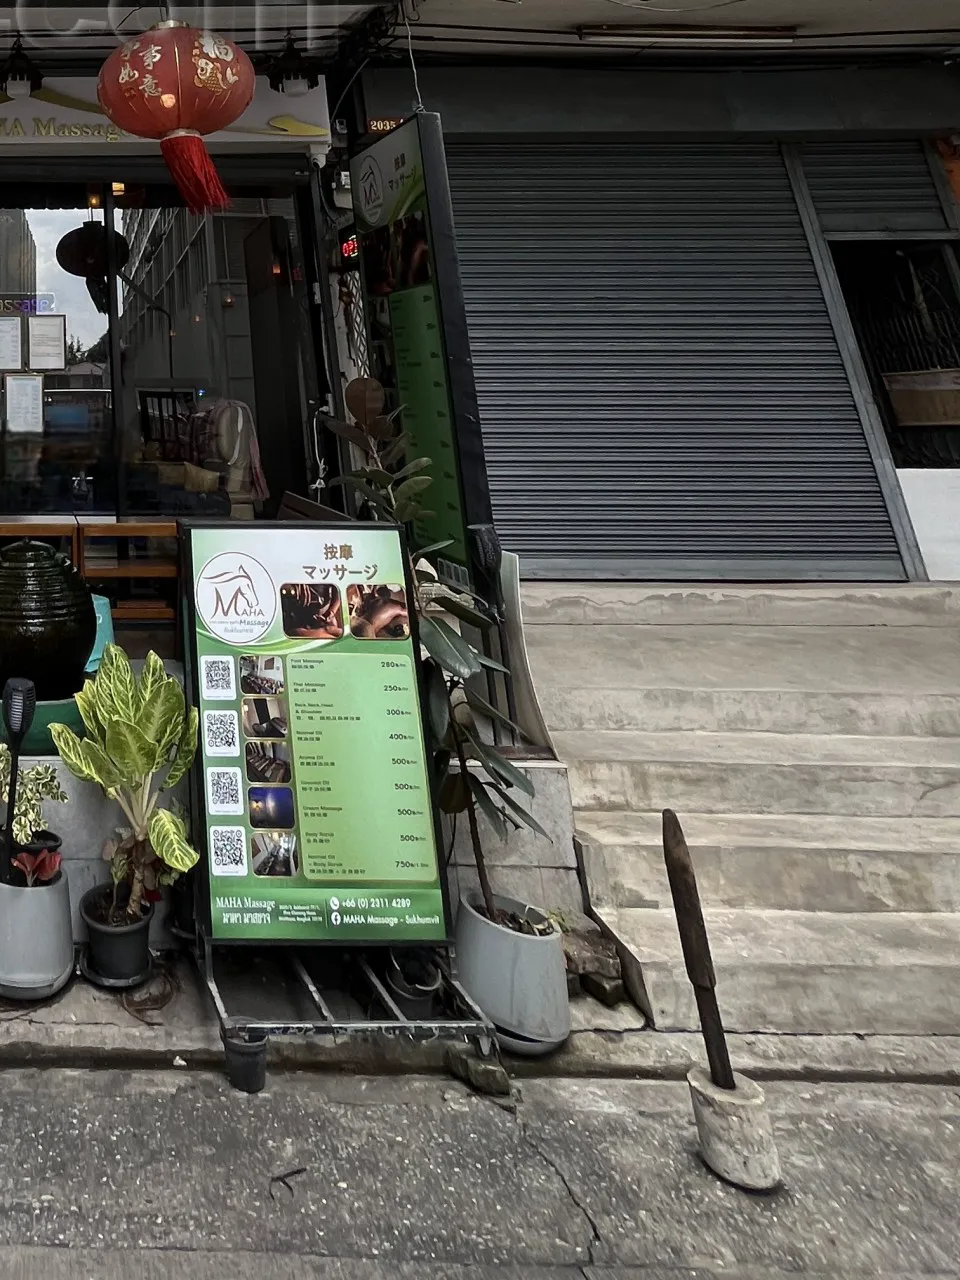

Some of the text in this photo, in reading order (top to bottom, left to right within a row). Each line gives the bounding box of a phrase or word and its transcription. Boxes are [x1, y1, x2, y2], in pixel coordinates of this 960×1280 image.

[32, 117, 129, 142] Massag
[324, 543, 354, 560] 按摩
[302, 564, 378, 580] マッサージ
[210, 586, 265, 619] MAHA
[239, 619, 271, 628] Massage
[216, 897, 275, 912] MAHA Massage
[342, 898, 411, 909] +66 (0) 2311 4289
[343, 914, 366, 924] MAHA
[367, 914, 398, 926] Massage
[405, 914, 439, 924] Sukhumvit
